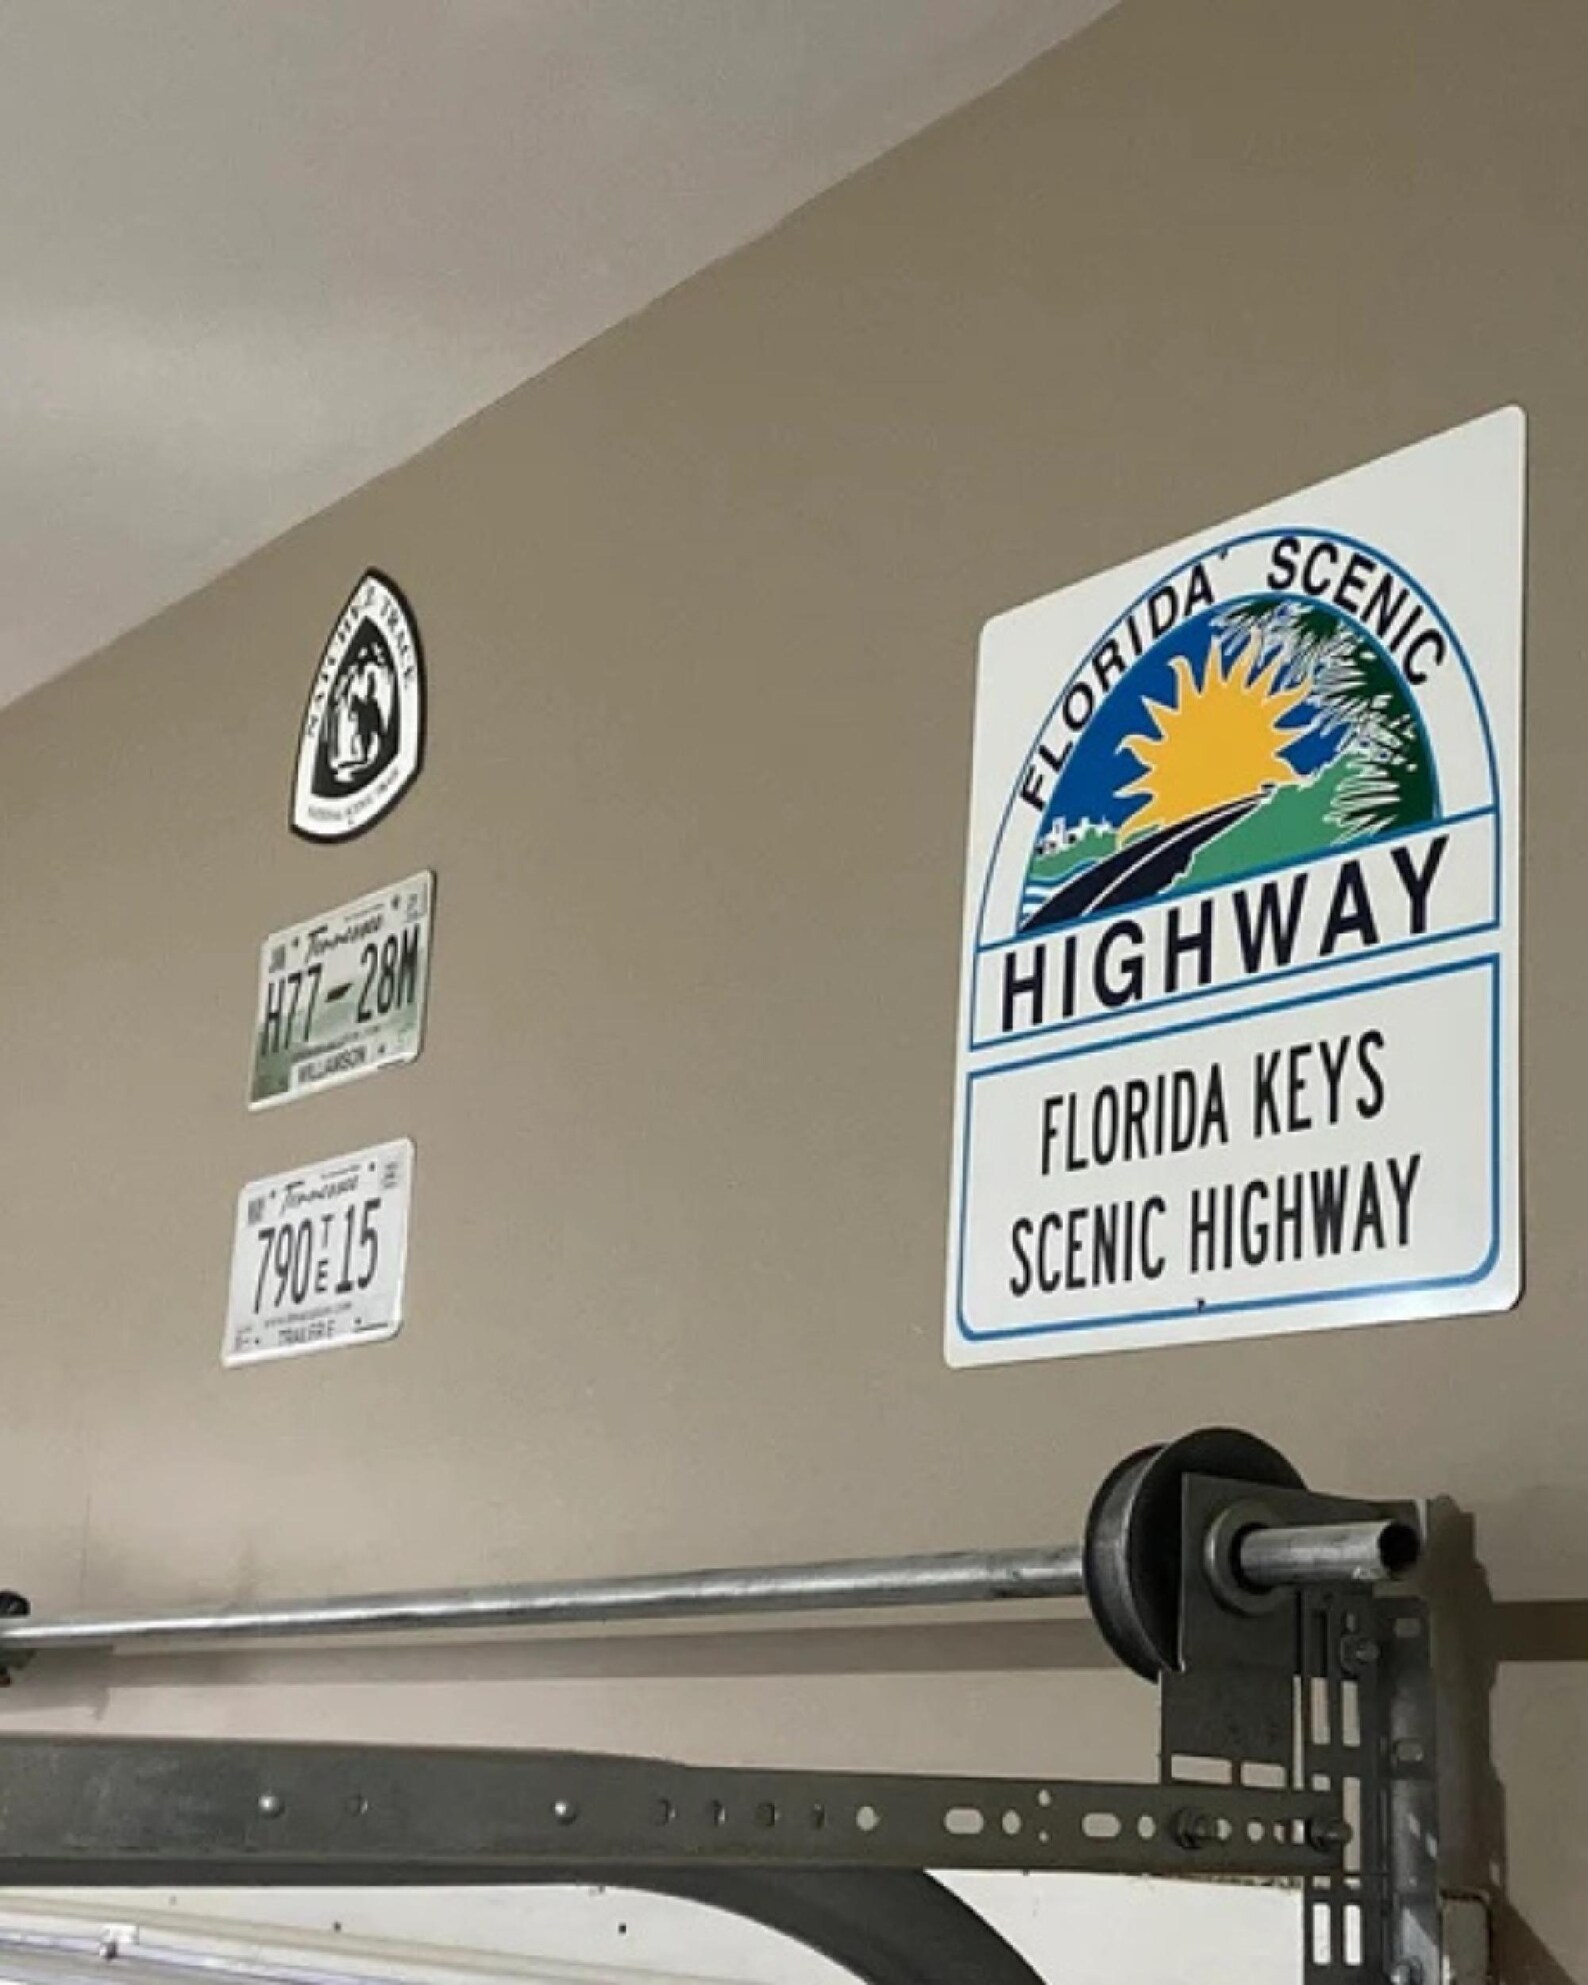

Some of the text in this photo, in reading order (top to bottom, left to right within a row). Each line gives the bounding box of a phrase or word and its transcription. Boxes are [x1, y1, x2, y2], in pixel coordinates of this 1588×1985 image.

[1018, 536, 1446, 813] FLORIDA SCENIC
[1001, 833, 1450, 1033] HIGHWAY
[1041, 1029, 1385, 1176] FLORIDA KEYS
[1009, 1153, 1422, 1296] SCENIC HIGHWAY
